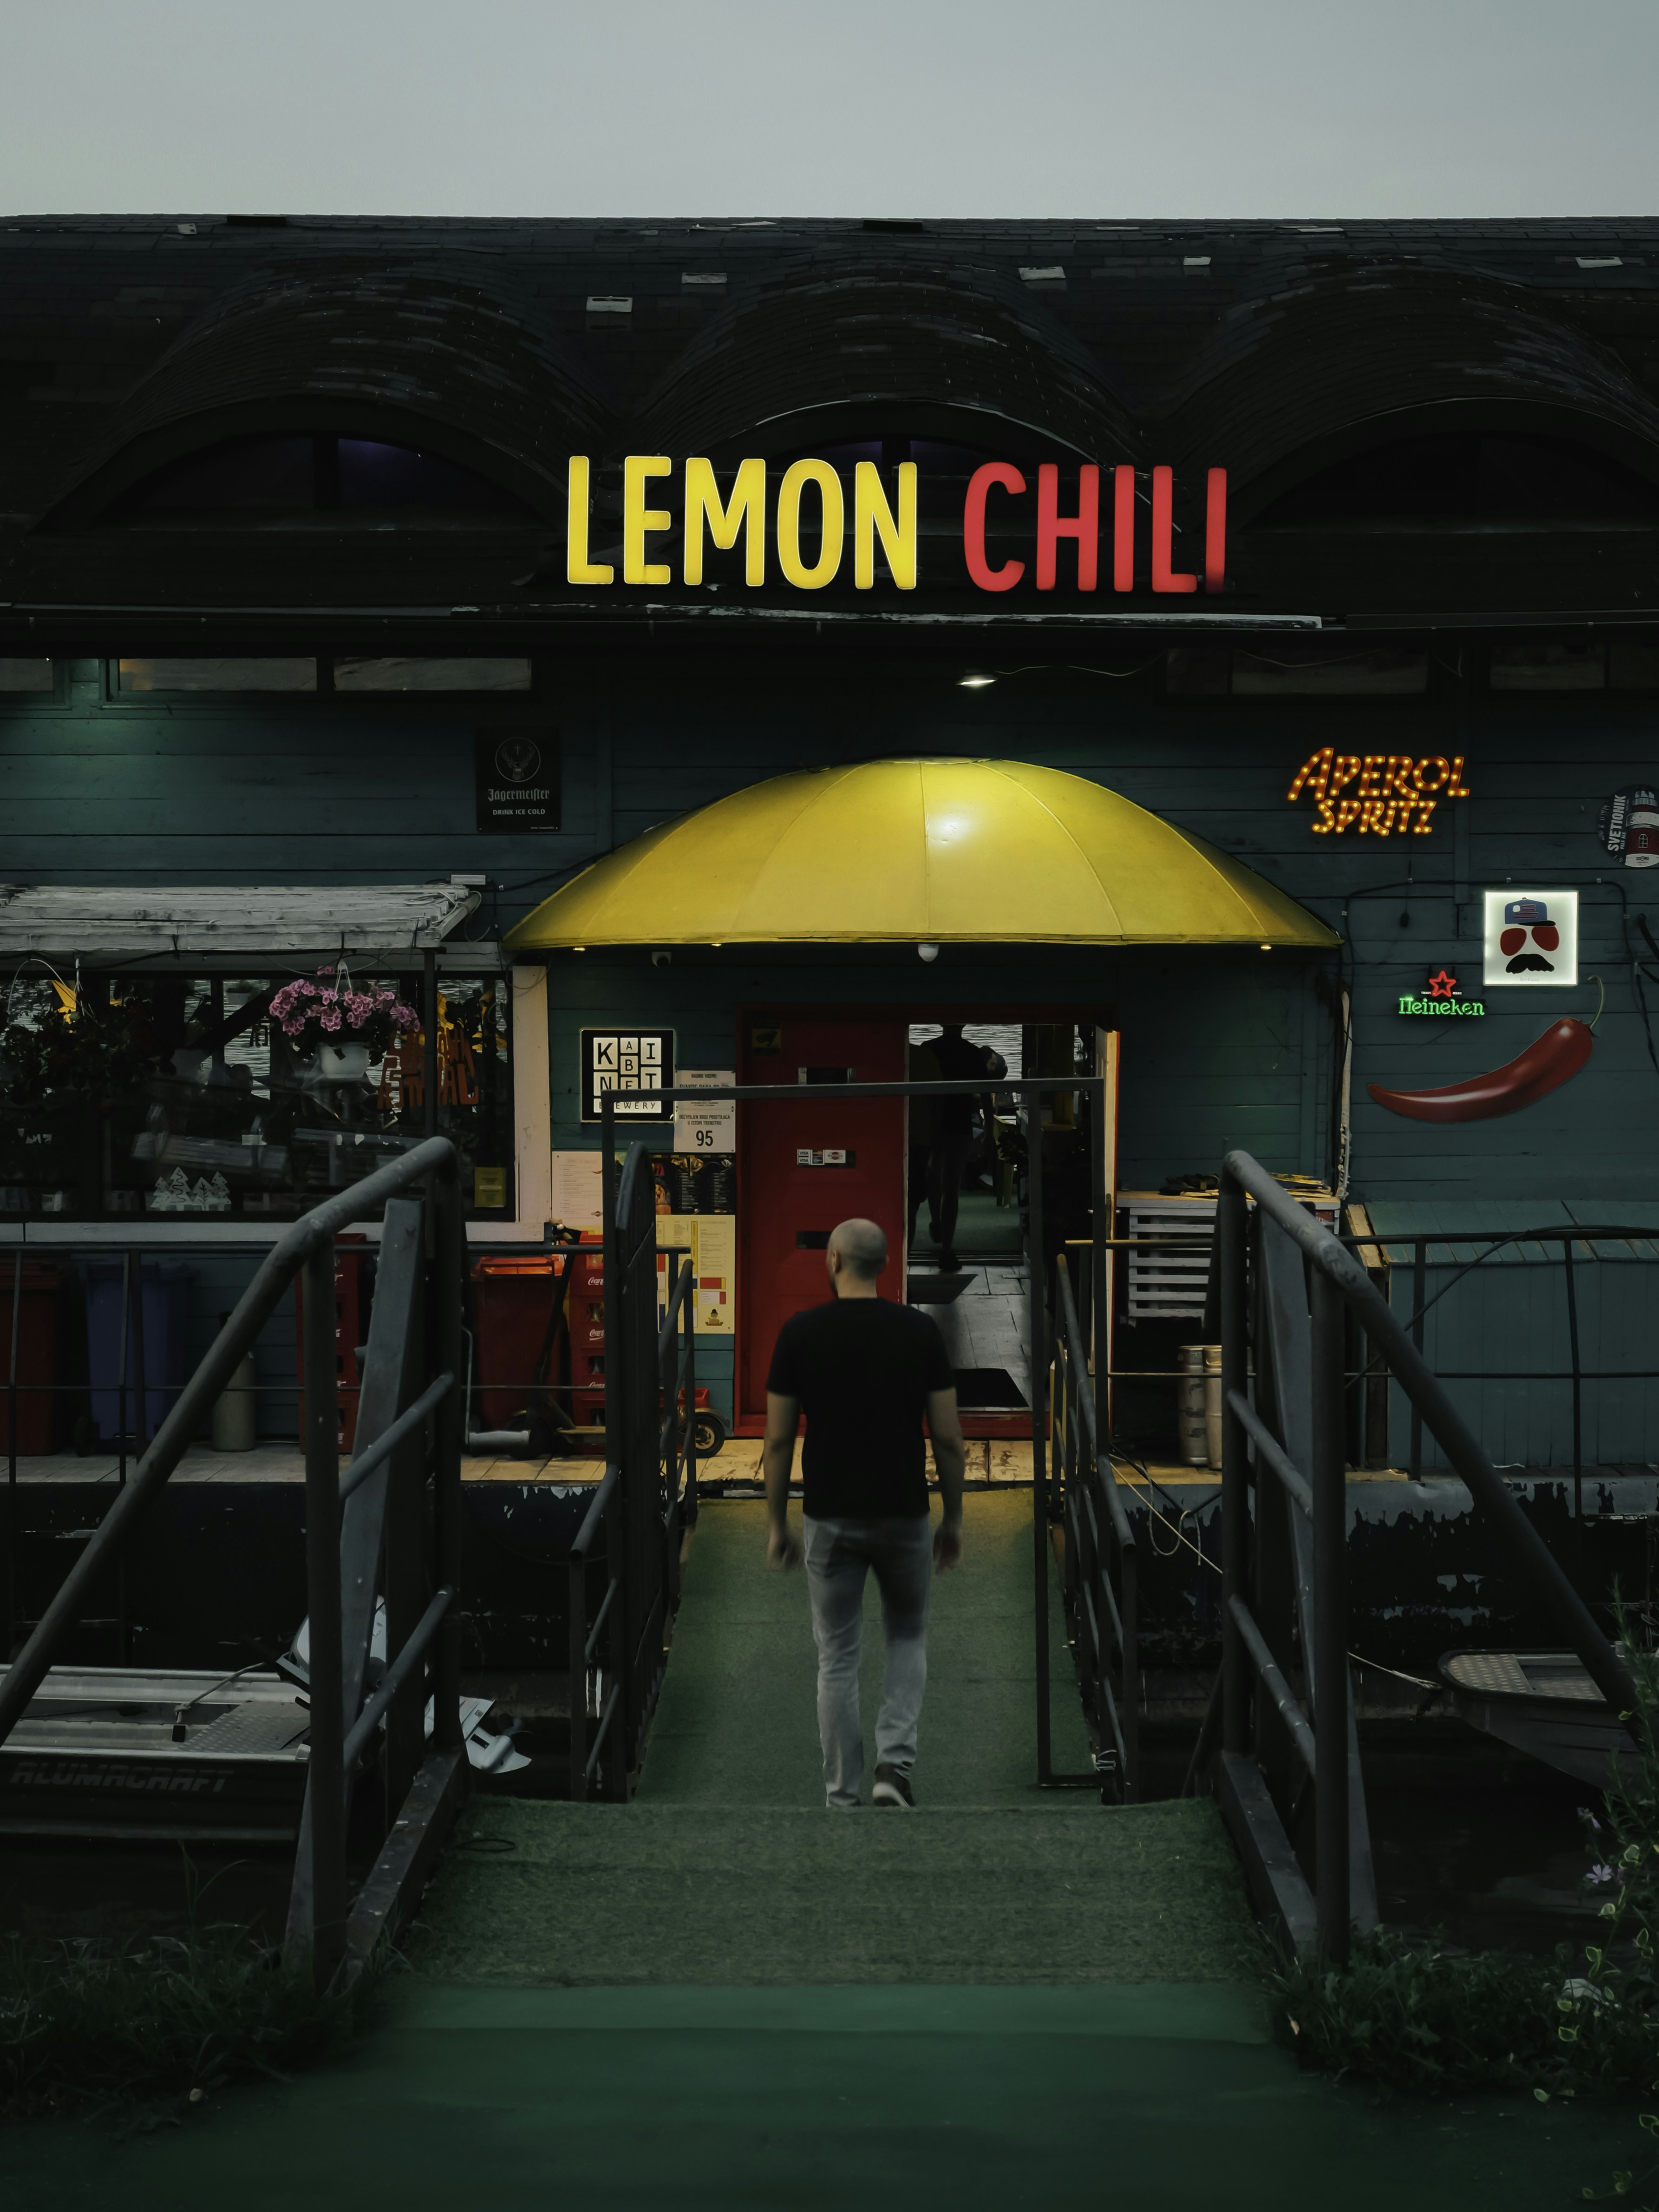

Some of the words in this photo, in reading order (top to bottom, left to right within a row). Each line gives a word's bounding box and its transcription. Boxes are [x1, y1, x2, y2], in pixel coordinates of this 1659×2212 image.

[567, 456, 917, 589] LEMON
[964, 462, 1227, 593] CHILI
[1287, 747, 1470, 800] APEROL
[1607, 794, 1626, 851] SVETIONIK
[1398, 997, 1485, 1015] Heineken
[696, 1130, 713, 1146] 95
[9, 1761, 234, 1792] ALUMACRAFT
